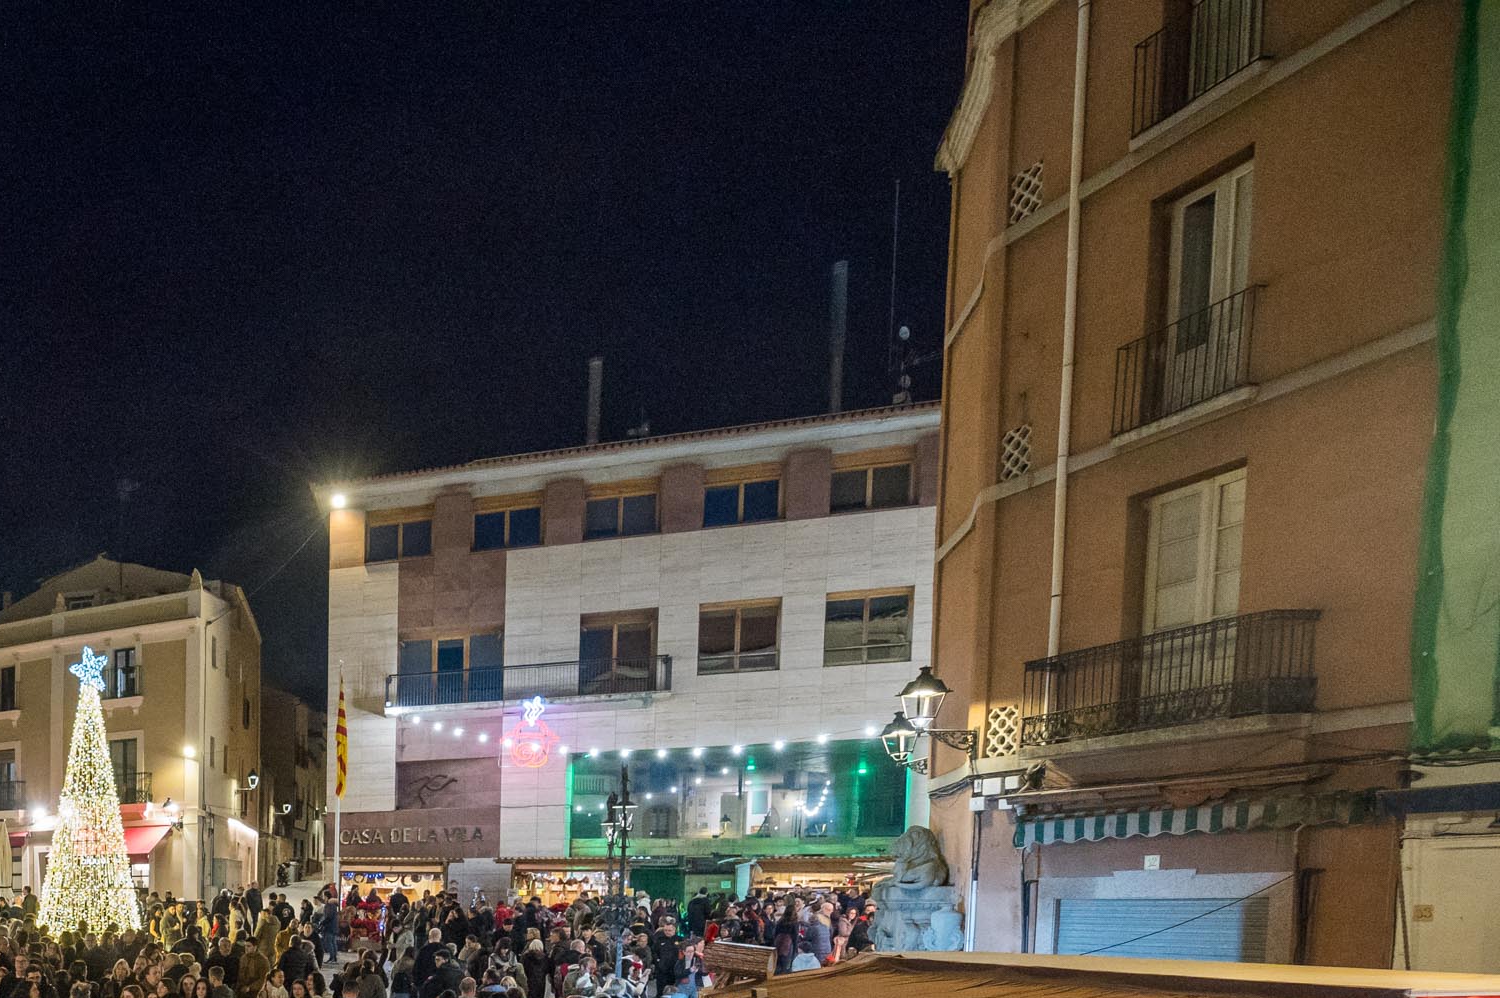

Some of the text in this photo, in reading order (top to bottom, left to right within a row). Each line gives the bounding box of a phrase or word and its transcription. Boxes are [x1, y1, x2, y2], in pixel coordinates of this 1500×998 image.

[339, 828, 385, 845] CASA
[390, 827, 412, 844] DE
[417, 827, 438, 843] LA
